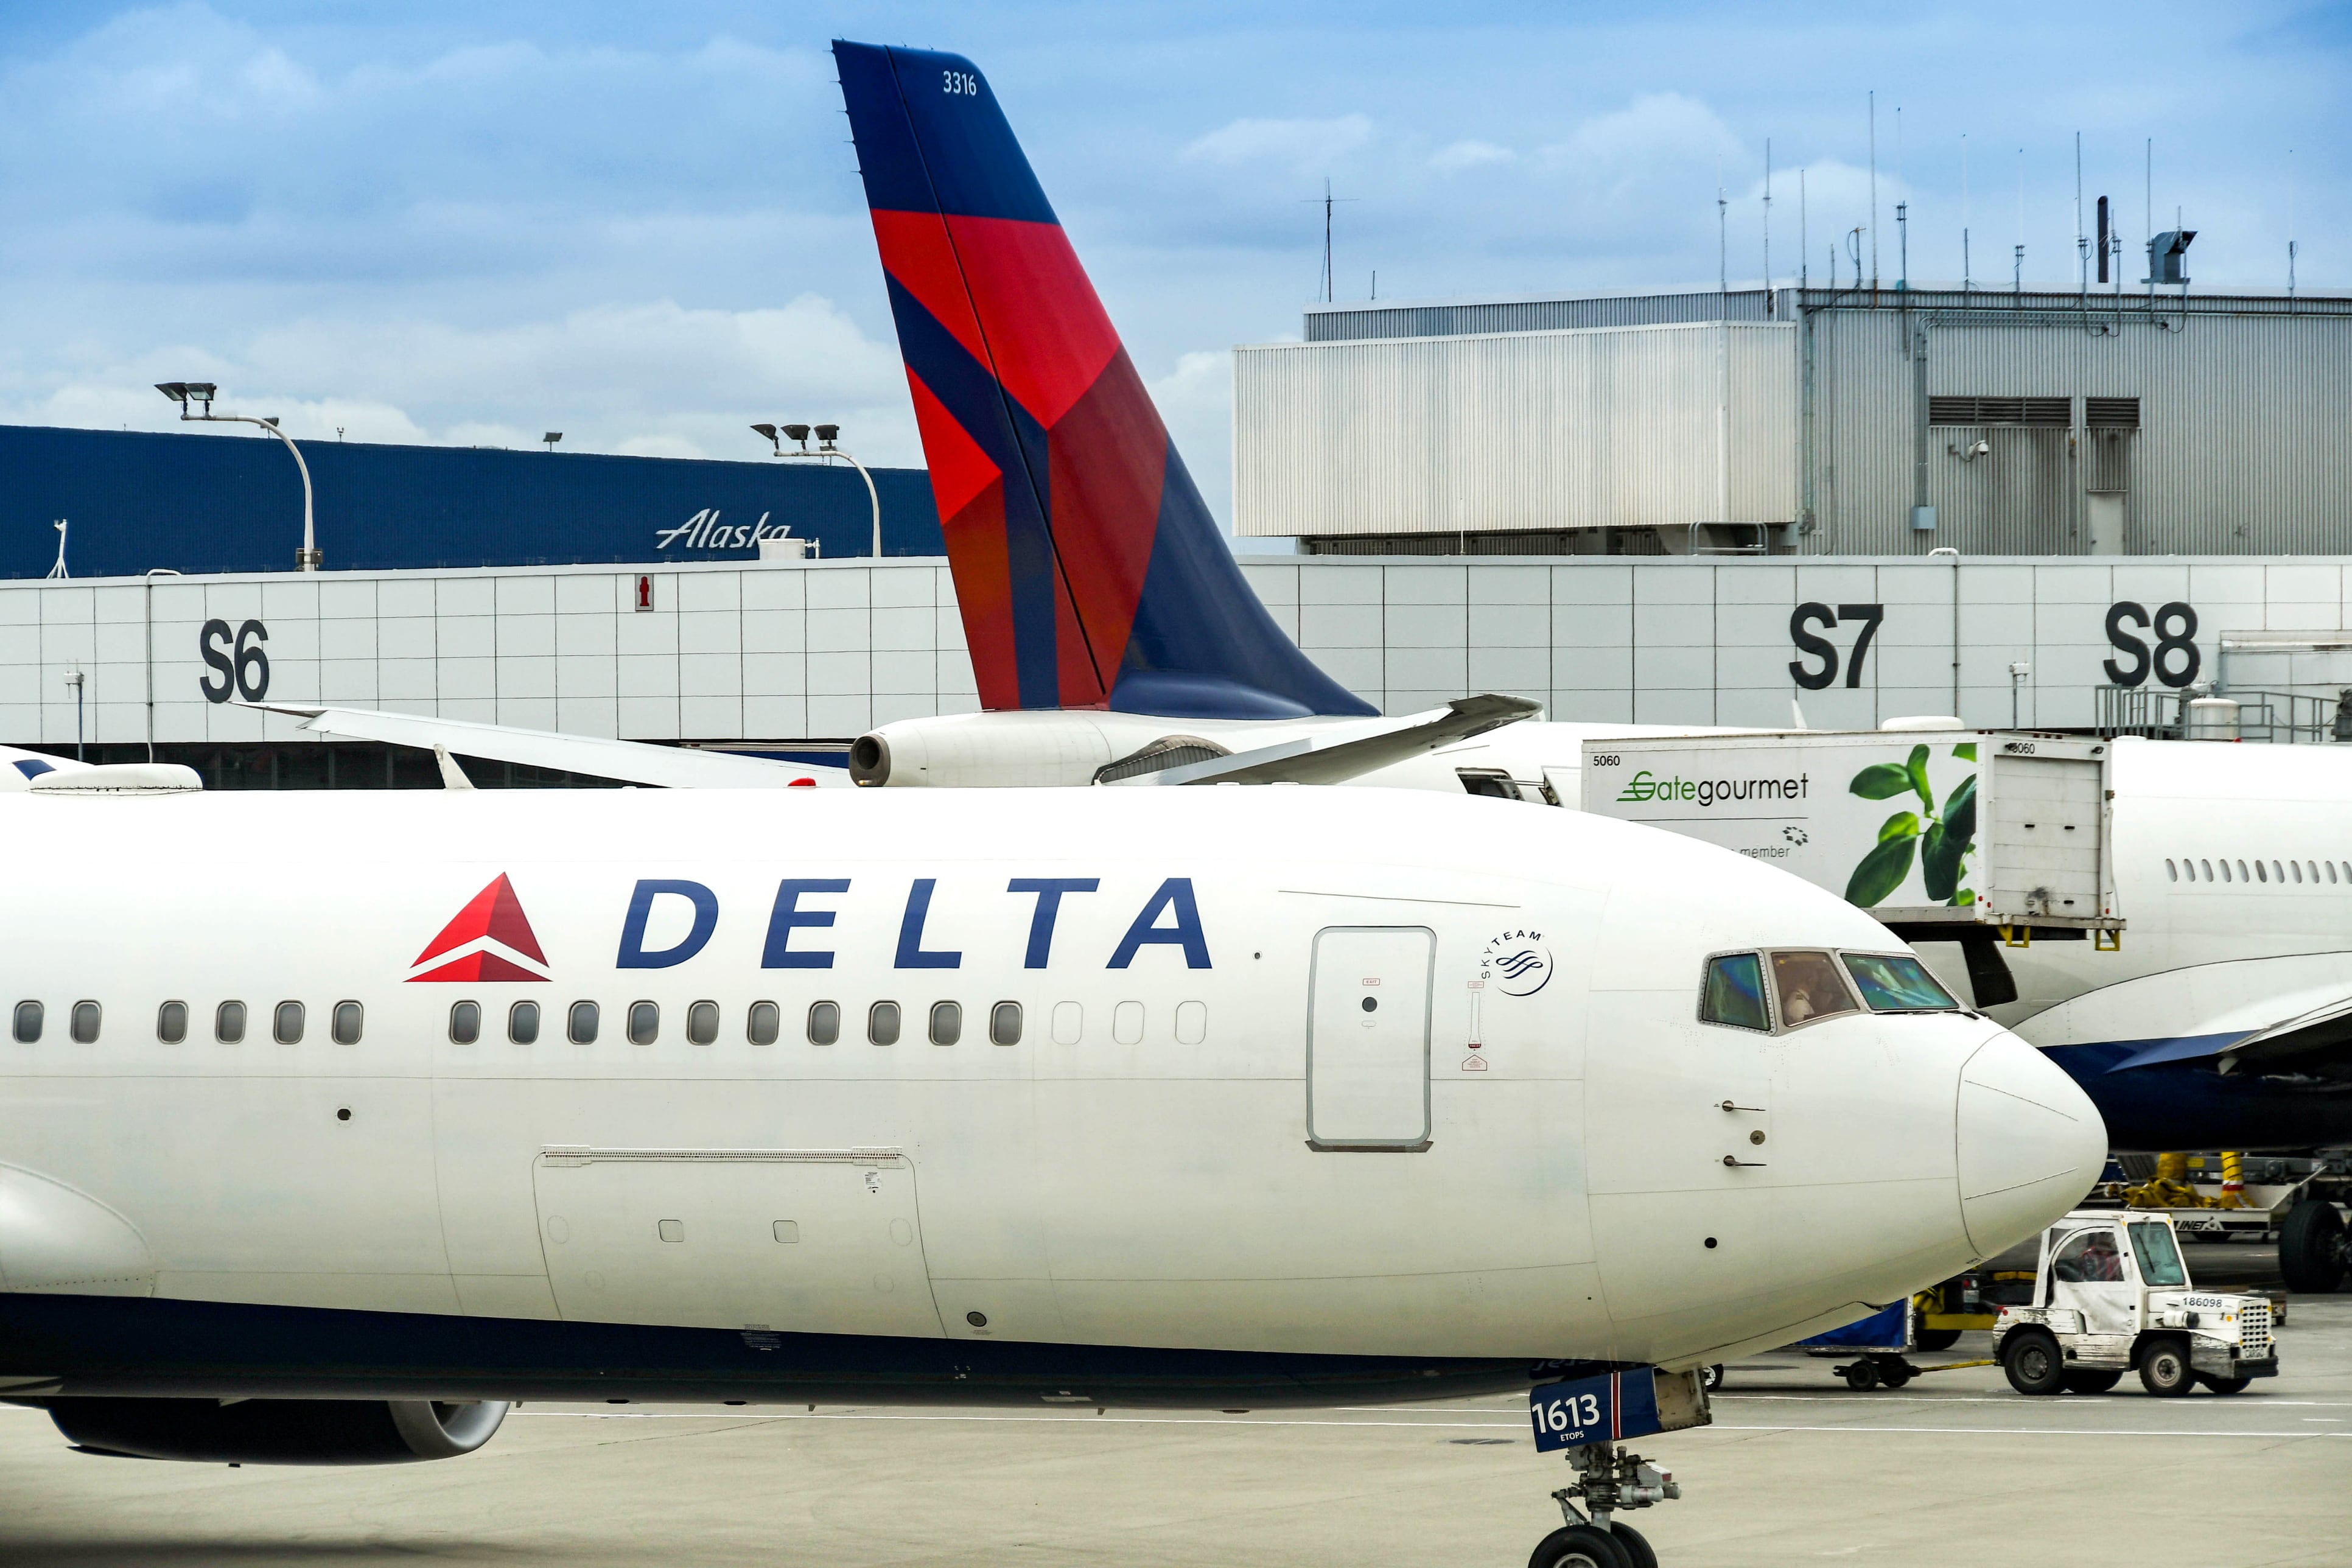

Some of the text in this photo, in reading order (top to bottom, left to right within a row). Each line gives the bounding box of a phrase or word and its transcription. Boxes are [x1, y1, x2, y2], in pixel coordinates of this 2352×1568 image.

[943, 71, 976, 96] 3316
[656, 508, 791, 549] Alaska
[200, 618, 269, 703] S6
[1789, 602, 1884, 690] S7
[2104, 601, 2200, 687] S8
[1593, 755, 1620, 766] 5060
[1740, 845, 1790, 858] member
[616, 878, 1212, 969] DELTA
[1480, 929, 1541, 979] SKYTEAM
[2183, 1297, 2222, 1307] 186098
[1531, 1394, 1600, 1433] 1613
[1560, 1431, 1584, 1442] ETOPS
